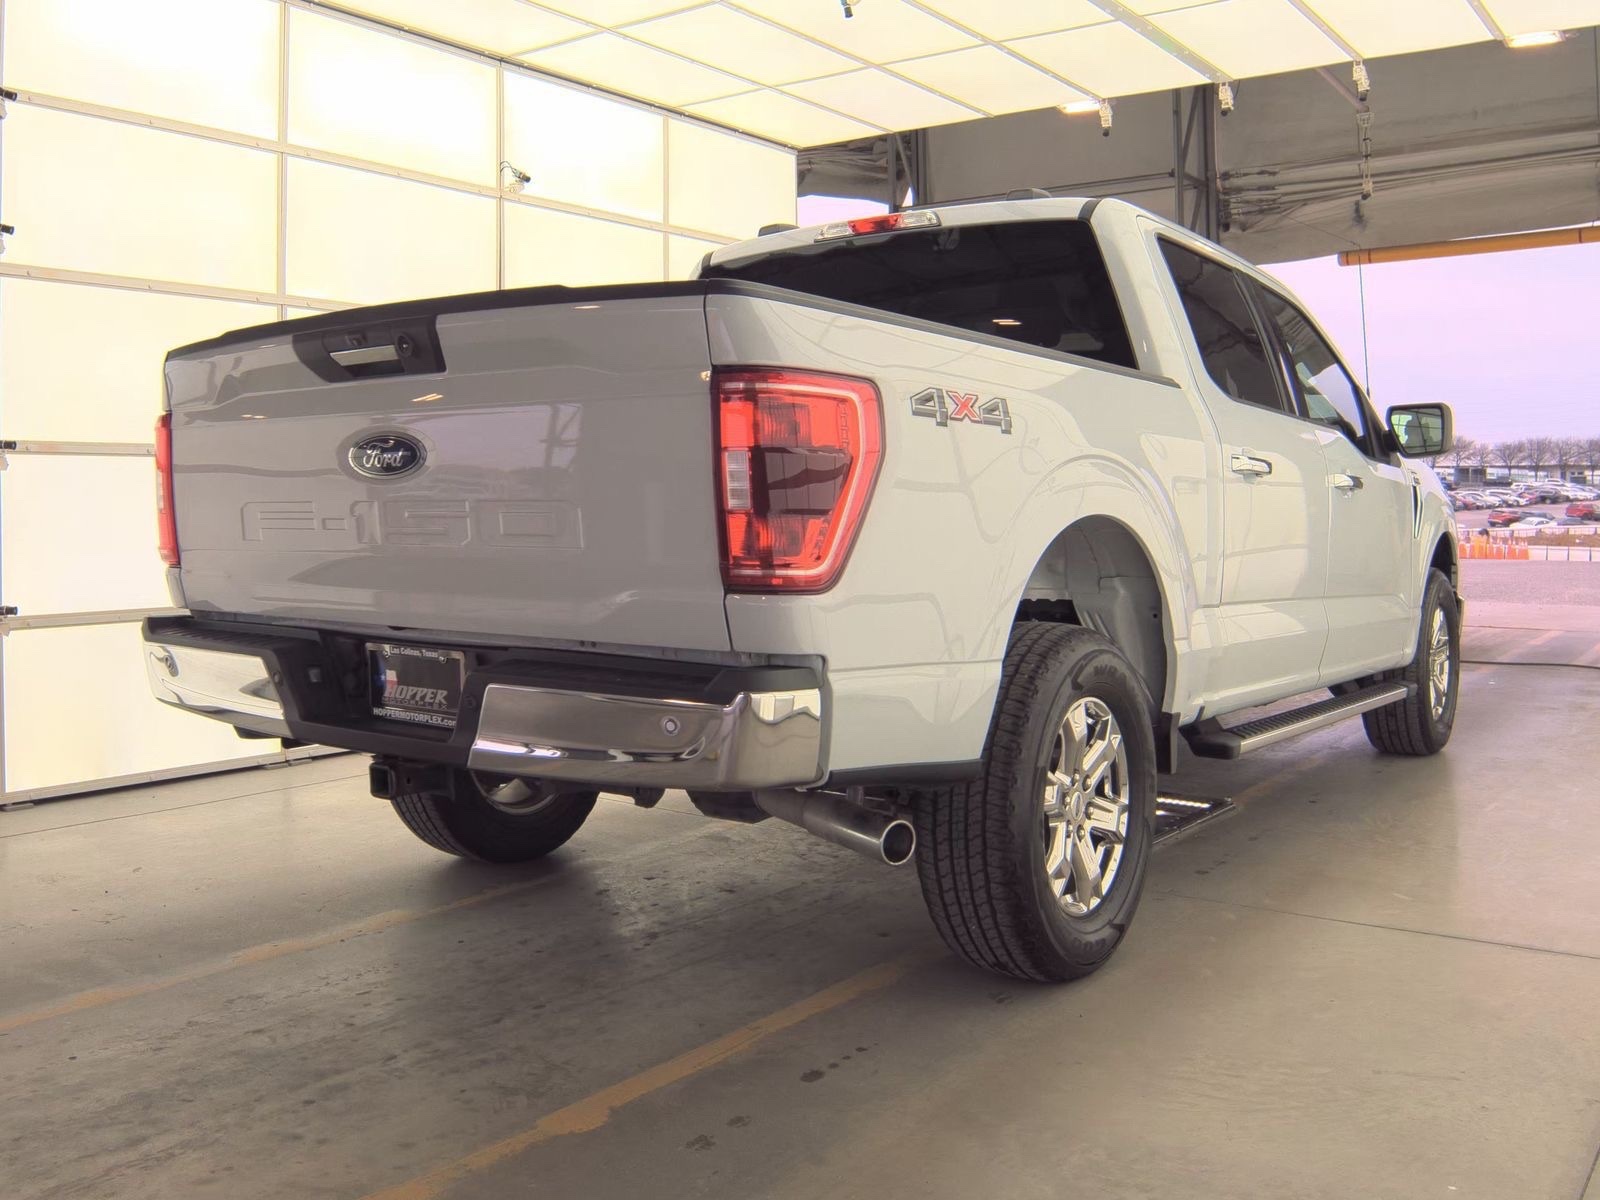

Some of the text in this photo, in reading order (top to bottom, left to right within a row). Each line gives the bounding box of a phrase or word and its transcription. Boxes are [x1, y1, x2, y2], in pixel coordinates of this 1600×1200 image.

[363, 441, 405, 468] Ford
[241, 500, 584, 550] F-150
[390, 646, 400, 655] Las
[422, 649, 438, 658] Texas
[384, 685, 448, 704] HOPPER
